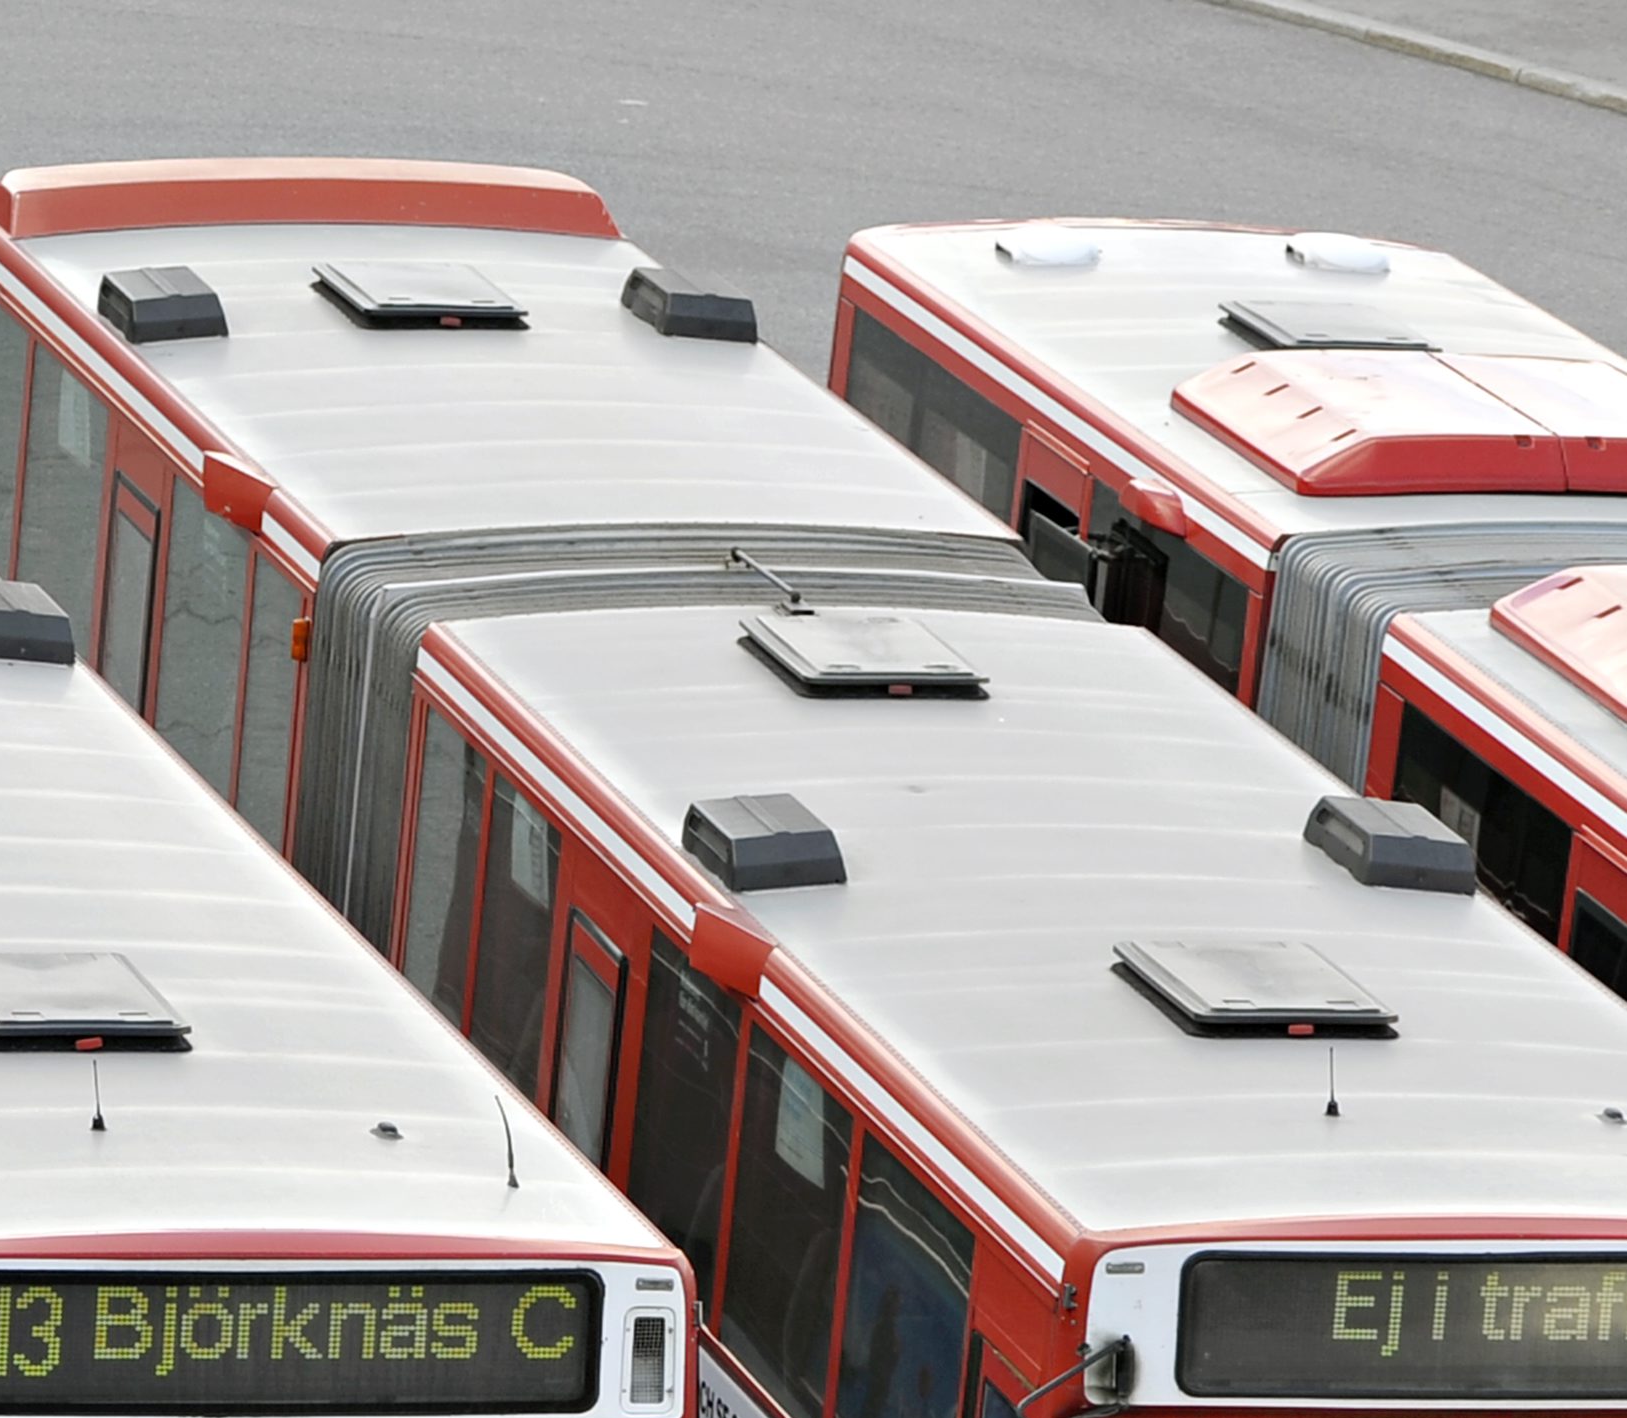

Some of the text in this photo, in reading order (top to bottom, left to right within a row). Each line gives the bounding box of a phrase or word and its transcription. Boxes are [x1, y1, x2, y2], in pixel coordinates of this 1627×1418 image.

[94, 1286, 479, 1376] Björknäs
[510, 1286, 577, 1360] C
[1332, 1271, 1627, 1356] Ej i traf
